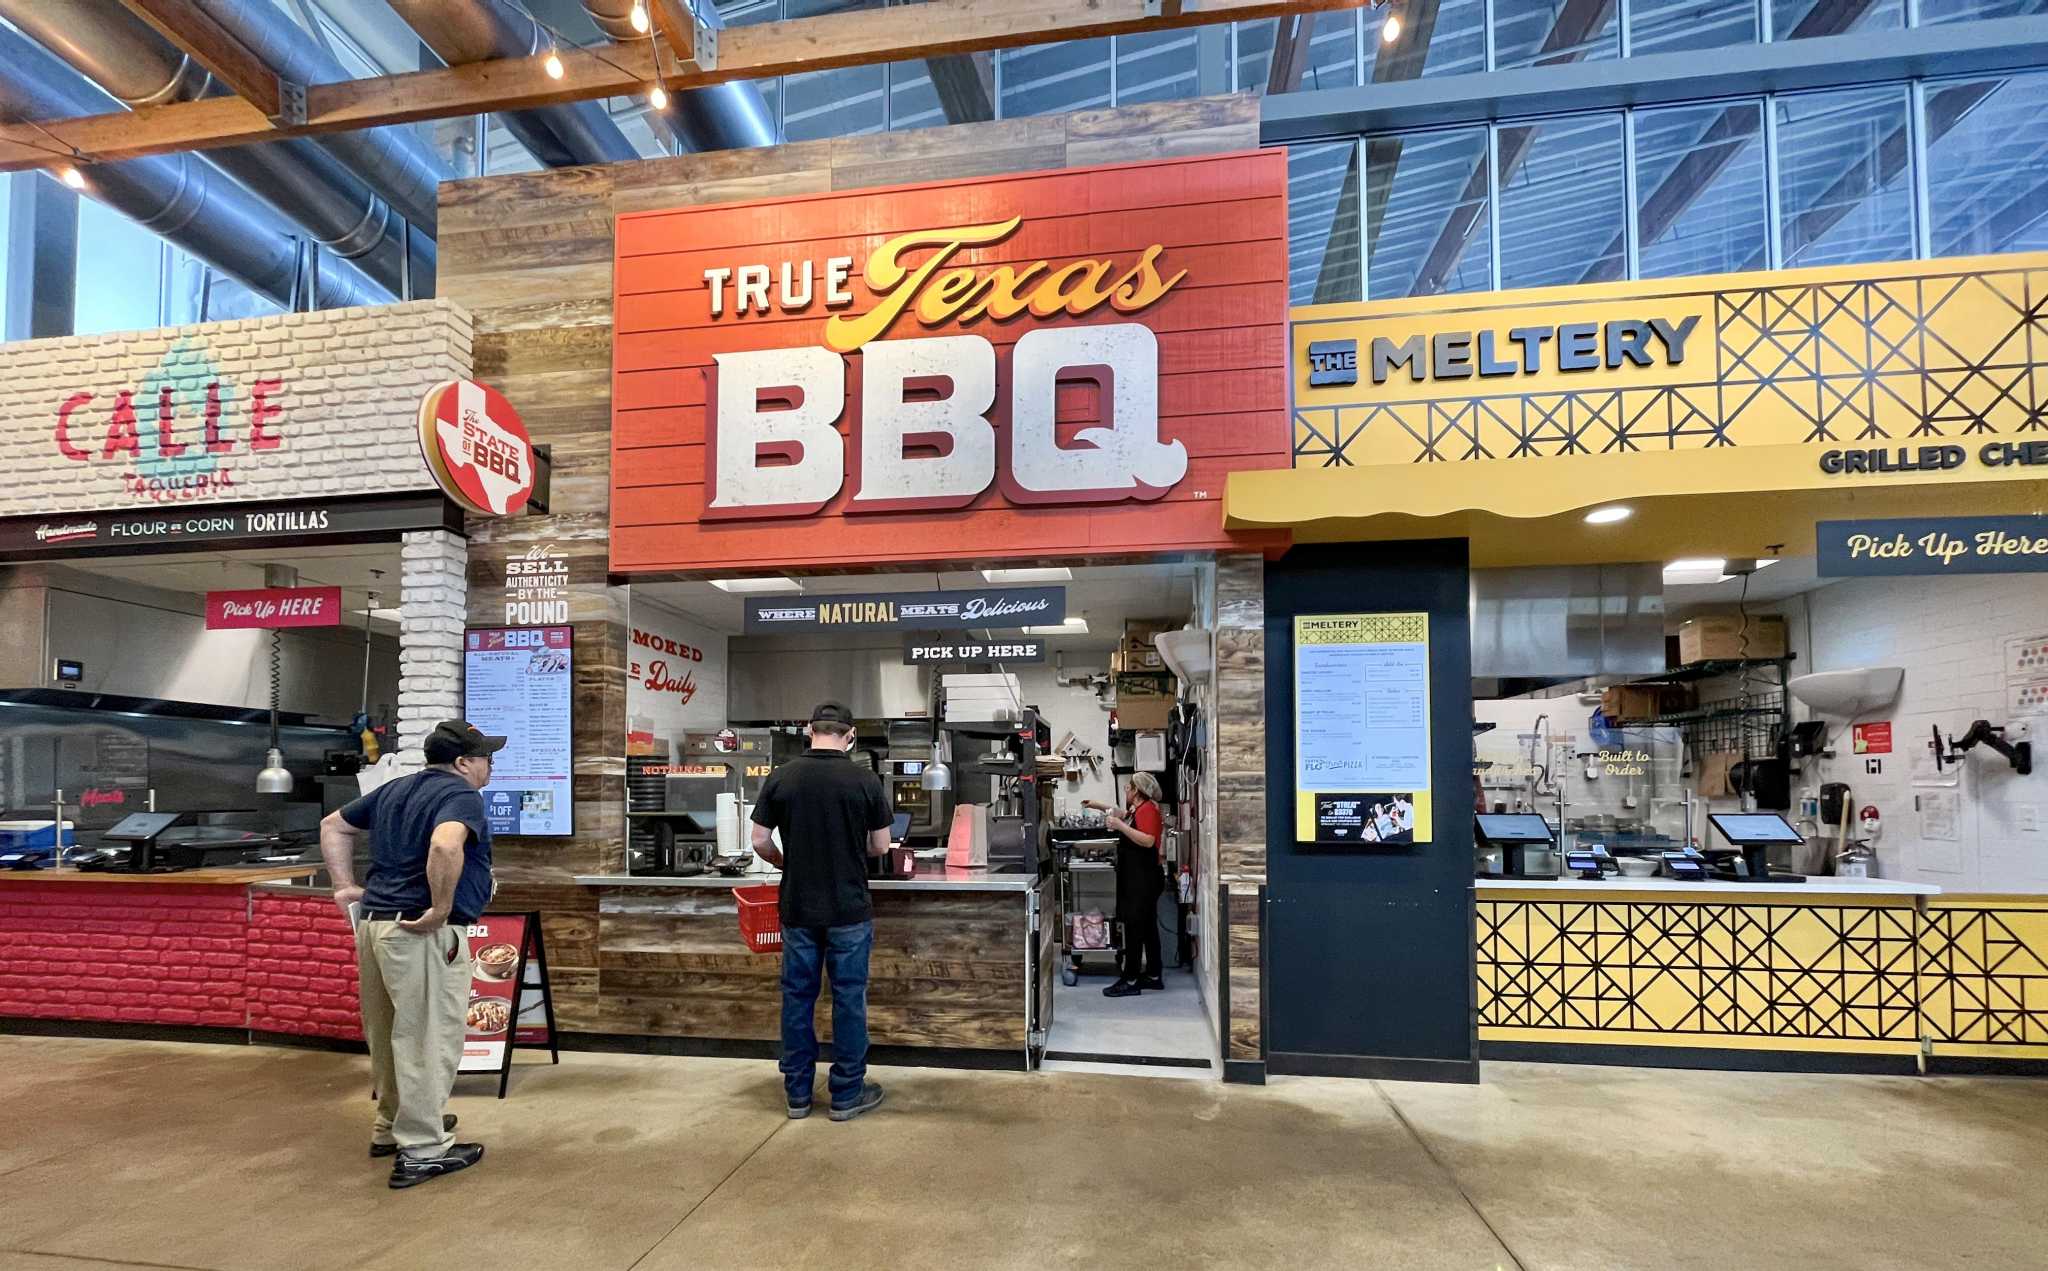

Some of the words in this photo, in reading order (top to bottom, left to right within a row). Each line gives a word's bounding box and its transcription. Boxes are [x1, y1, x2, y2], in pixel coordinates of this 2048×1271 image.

[704, 255, 855, 317] TRUE
[826, 214, 1189, 352] Texas
[1371, 315, 1701, 384] MELTERY
[55, 378, 283, 461] CALLE
[463, 409, 479, 424] The
[703, 321, 1190, 521] BBQ
[464, 421, 519, 461] STATE
[474, 441, 521, 484] BBQ
[1820, 445, 1966, 474] GRILLED
[122, 468, 234, 500] TAQUERIA
[1194, 491, 1207, 499] TM
[35, 522, 98, 541] Handmade
[111, 521, 167, 536] FLOUR
[185, 518, 235, 533] CORN
[246, 510, 328, 533] TORTILLAS
[1848, 534, 1912, 559] Pick
[1918, 532, 1968, 565] Up
[1975, 531, 2048, 556] Here
[506, 560, 569, 575] SELL
[505, 574, 569, 588] AUTHENTICITY
[518, 588, 534, 600] BY
[536, 587, 557, 599] THE
[223, 601, 253, 619] Pick
[254, 600, 275, 619] Up
[278, 597, 323, 616] HERE
[505, 600, 569, 626] POUND
[758, 610, 816, 620] WHERE
[819, 601, 898, 624] NATURAL
[901, 604, 959, 617] MEATS
[960, 598, 1049, 621] Delicious
[1311, 620, 1359, 630] MELTERY
[504, 630, 545, 648] BBQ
[629, 627, 703, 663] MOKED
[912, 646, 953, 659] PICK
[958, 646, 983, 658] UP
[987, 644, 1037, 658] HERE
[644, 659, 698, 706] Daily
[1599, 751, 1633, 763] Built
[1636, 751, 1649, 762] to
[1604, 764, 1645, 776] Order
[466, 925, 489, 938] BQ
